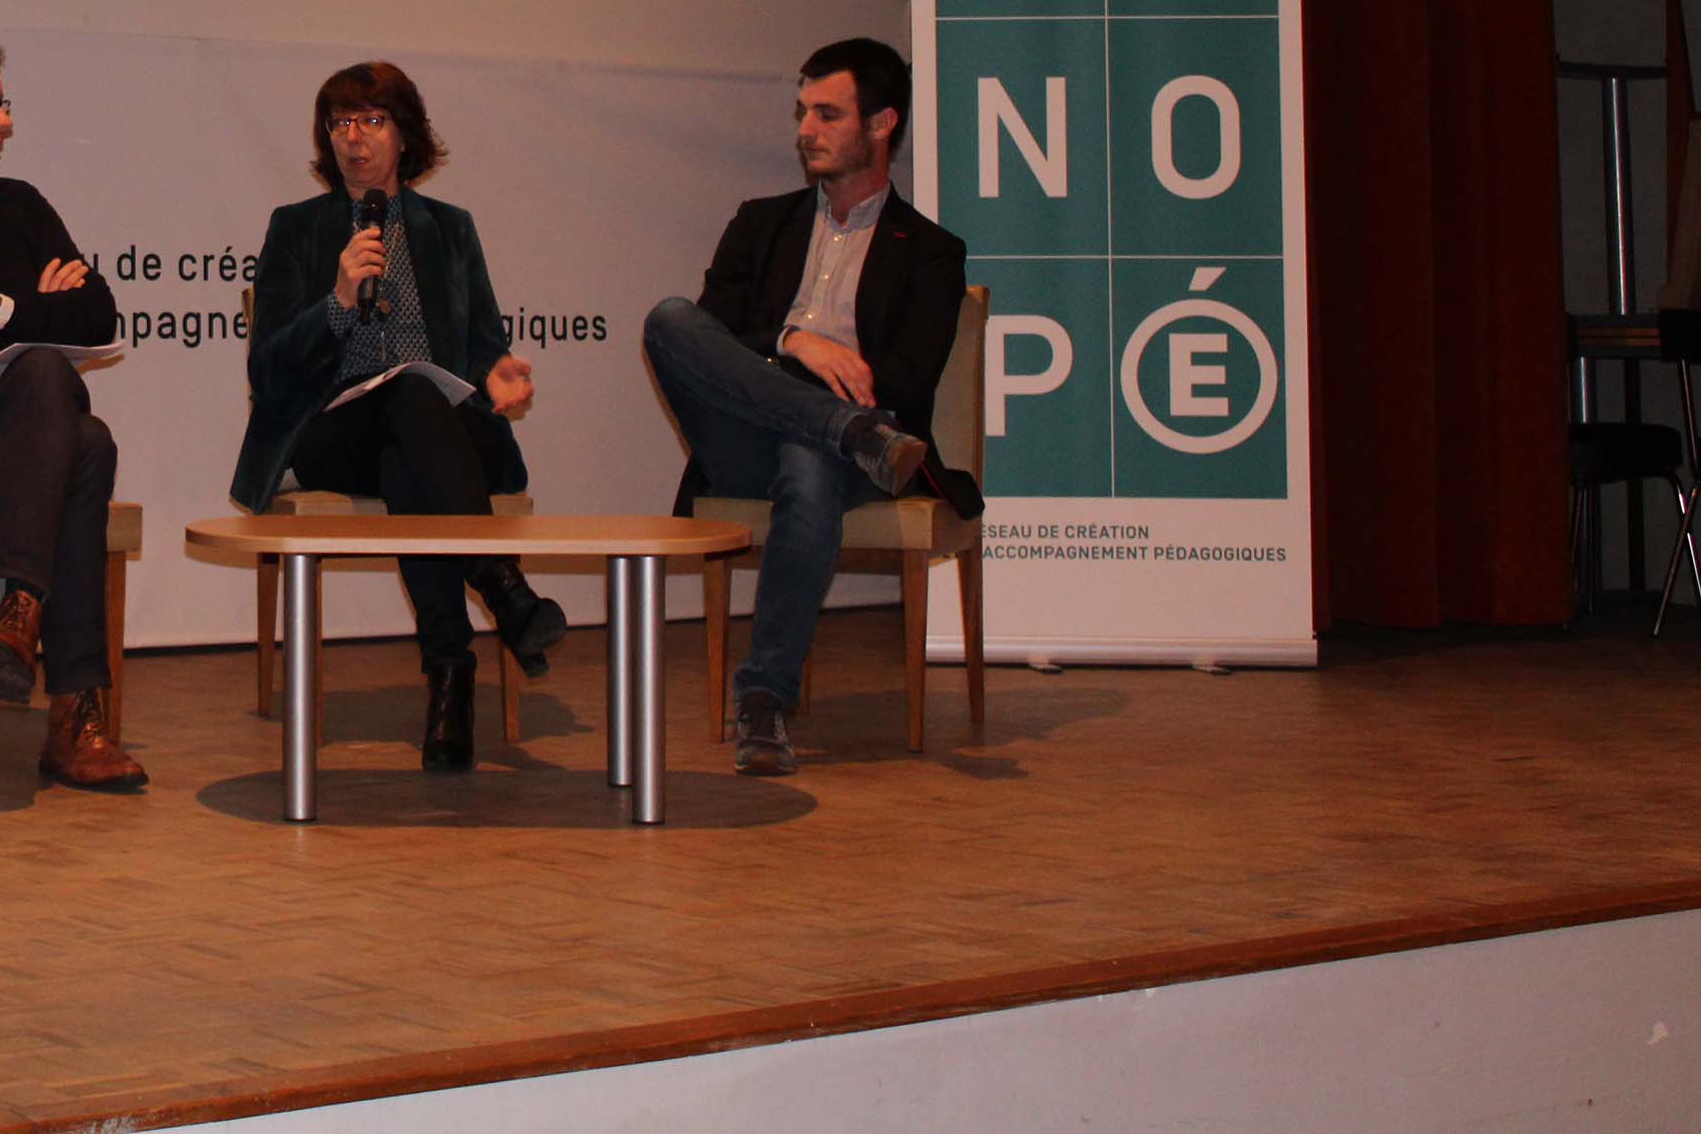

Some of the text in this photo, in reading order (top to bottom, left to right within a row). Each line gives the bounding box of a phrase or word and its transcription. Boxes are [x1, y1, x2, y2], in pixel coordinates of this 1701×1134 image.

[116, 244, 162, 281] de
[1037, 525, 1059, 539] DE
[1065, 522, 1150, 540] CRÉATION
[1154, 545, 1286, 562] PÉDAGOGIQUES
